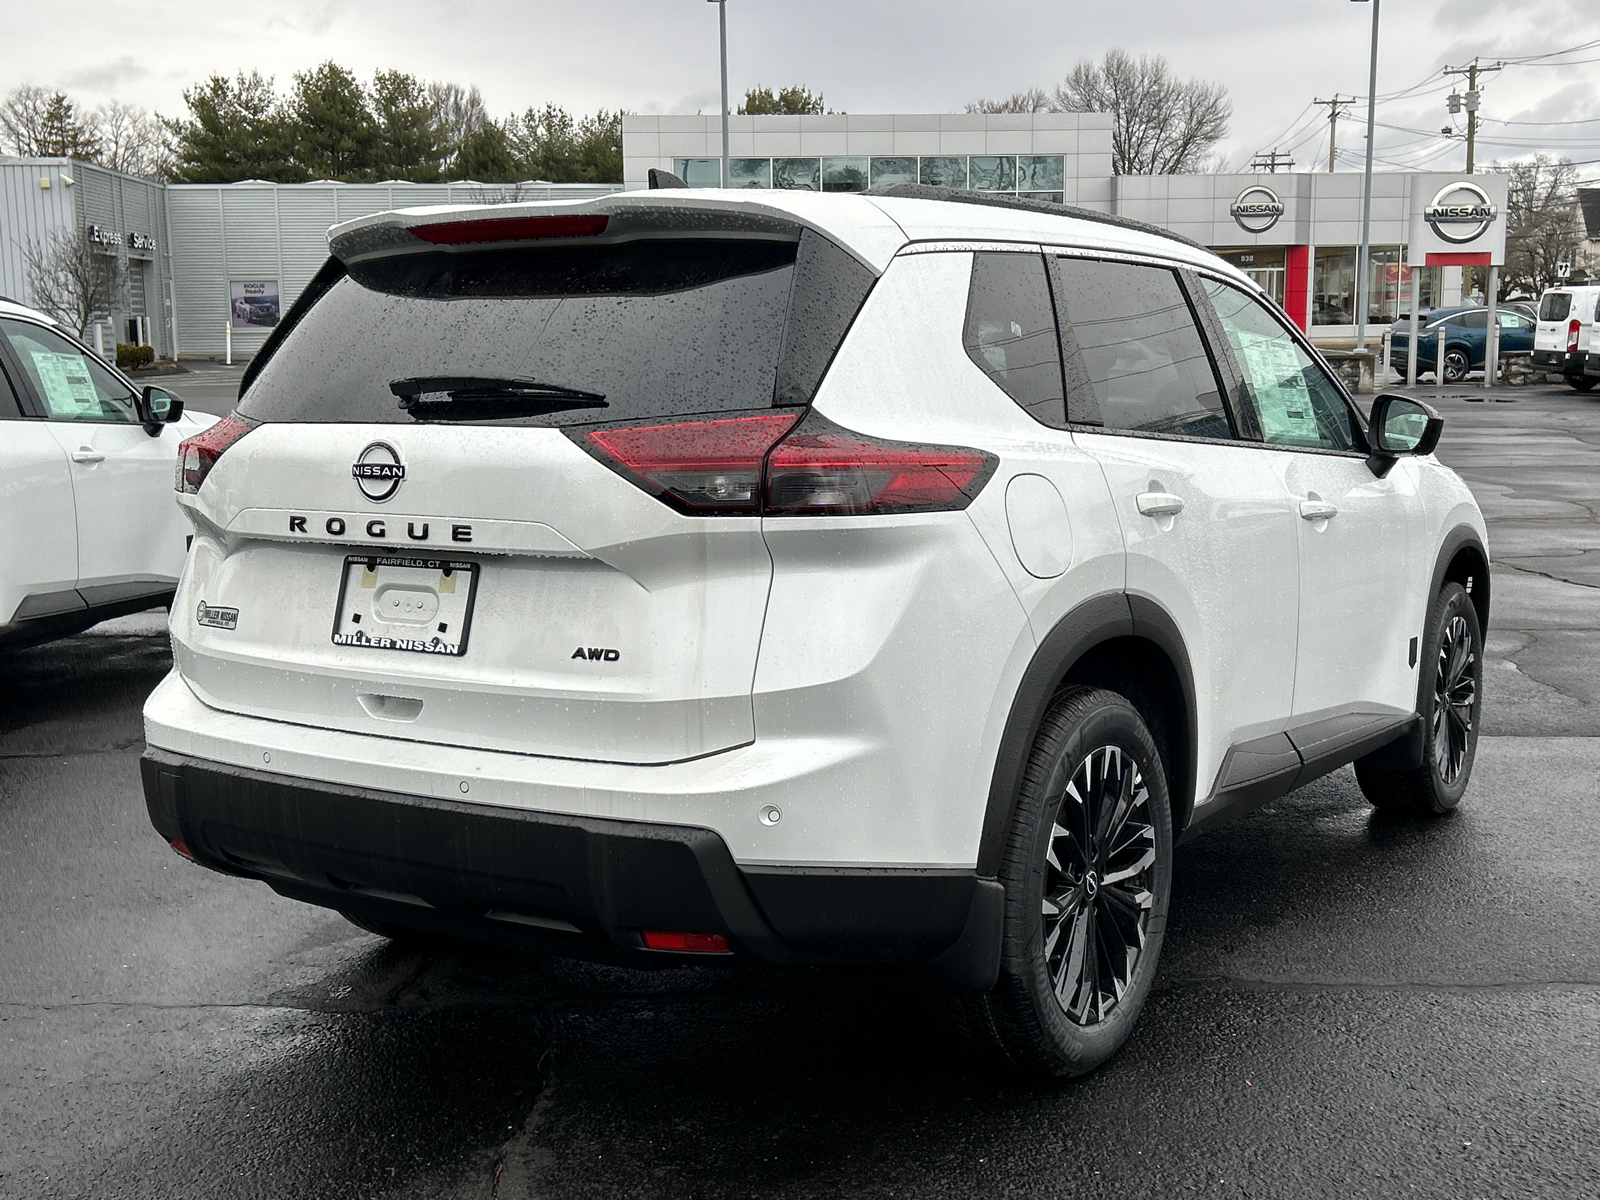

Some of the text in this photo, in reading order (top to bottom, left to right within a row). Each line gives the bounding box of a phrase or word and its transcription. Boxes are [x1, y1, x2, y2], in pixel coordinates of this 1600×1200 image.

[1236, 205, 1280, 213] NISSAN
[1432, 207, 1491, 218] NISSAN
[93, 225, 156, 250] Express Service
[353, 466, 403, 477] NISSAN
[289, 515, 473, 542] ROGUE
[376, 557, 441, 568] FAIRFIELD, CT
[333, 633, 459, 655] MILLER NISSAN
[570, 646, 620, 662] AWD
